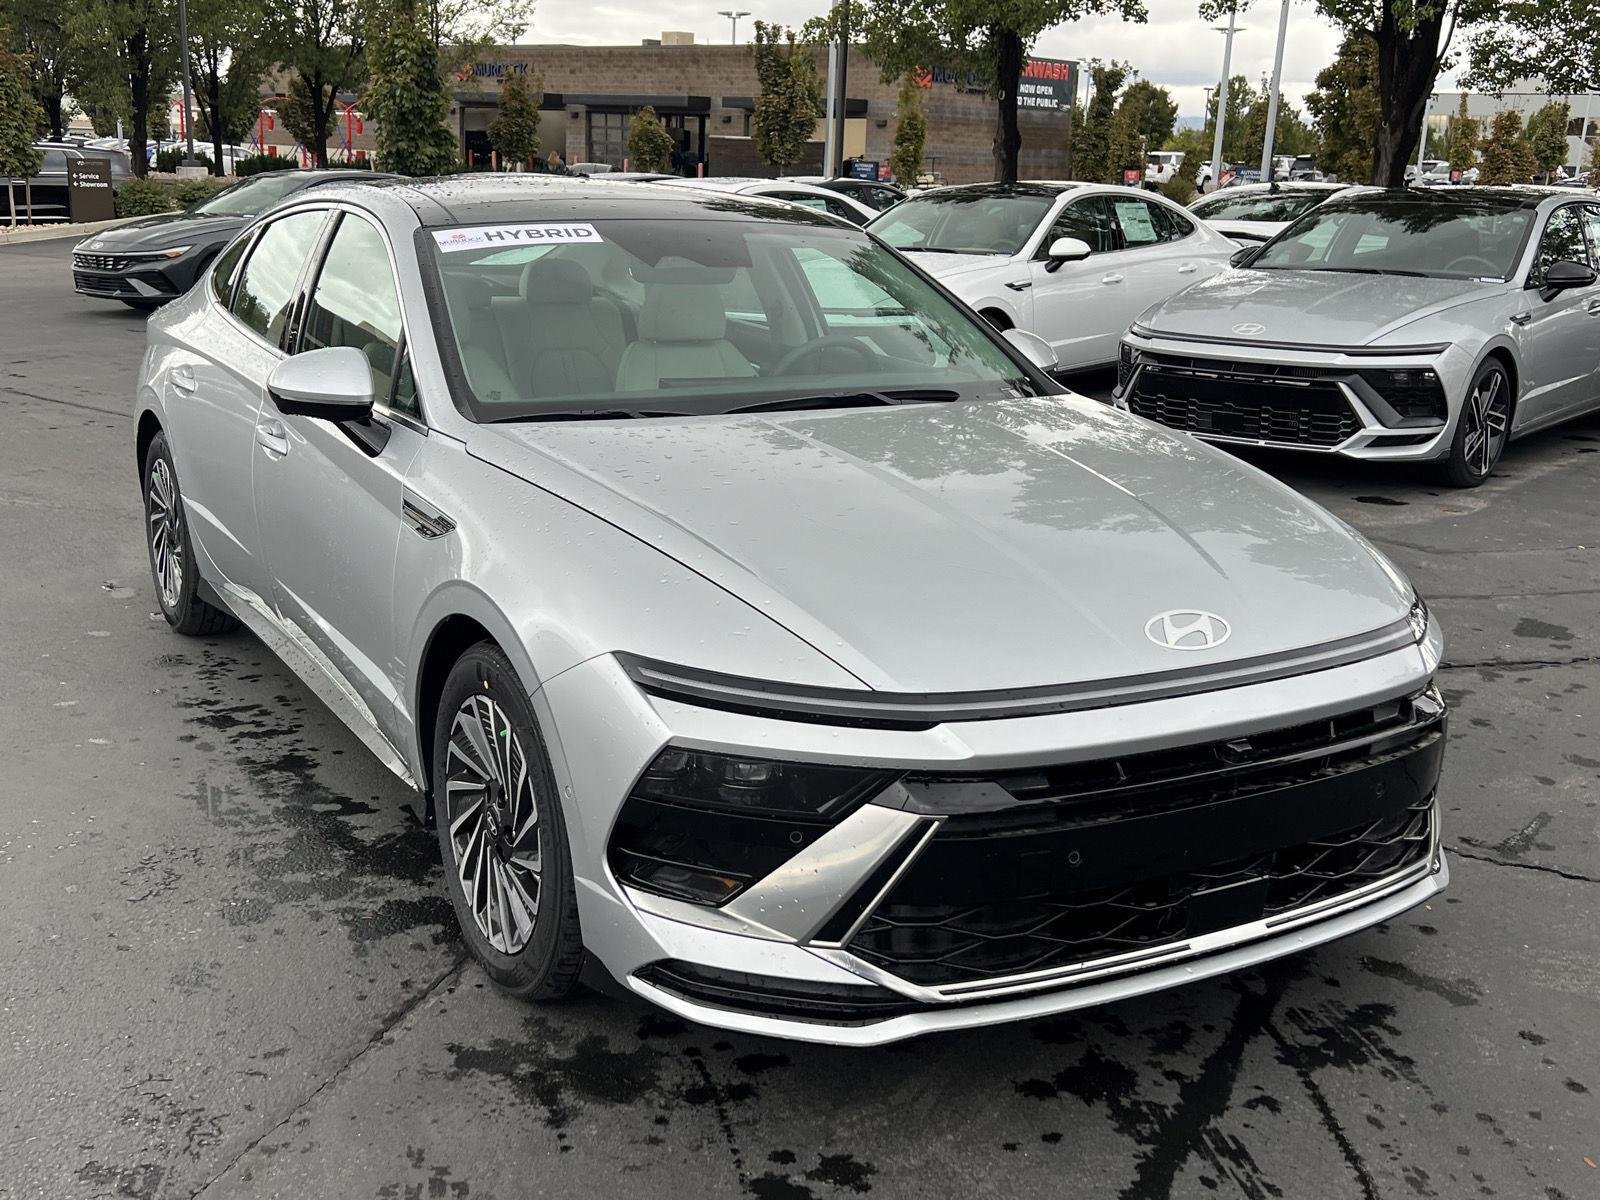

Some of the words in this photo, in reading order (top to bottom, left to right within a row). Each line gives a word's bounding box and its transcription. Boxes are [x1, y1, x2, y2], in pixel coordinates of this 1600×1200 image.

[1019, 84, 1035, 94] NOW
[1036, 85, 1053, 95] OPEN
[1023, 97, 1036, 107] THE
[1036, 98, 1058, 108] PUBLIC
[79, 172, 100, 180] Service
[484, 228, 593, 241] HYBRID
